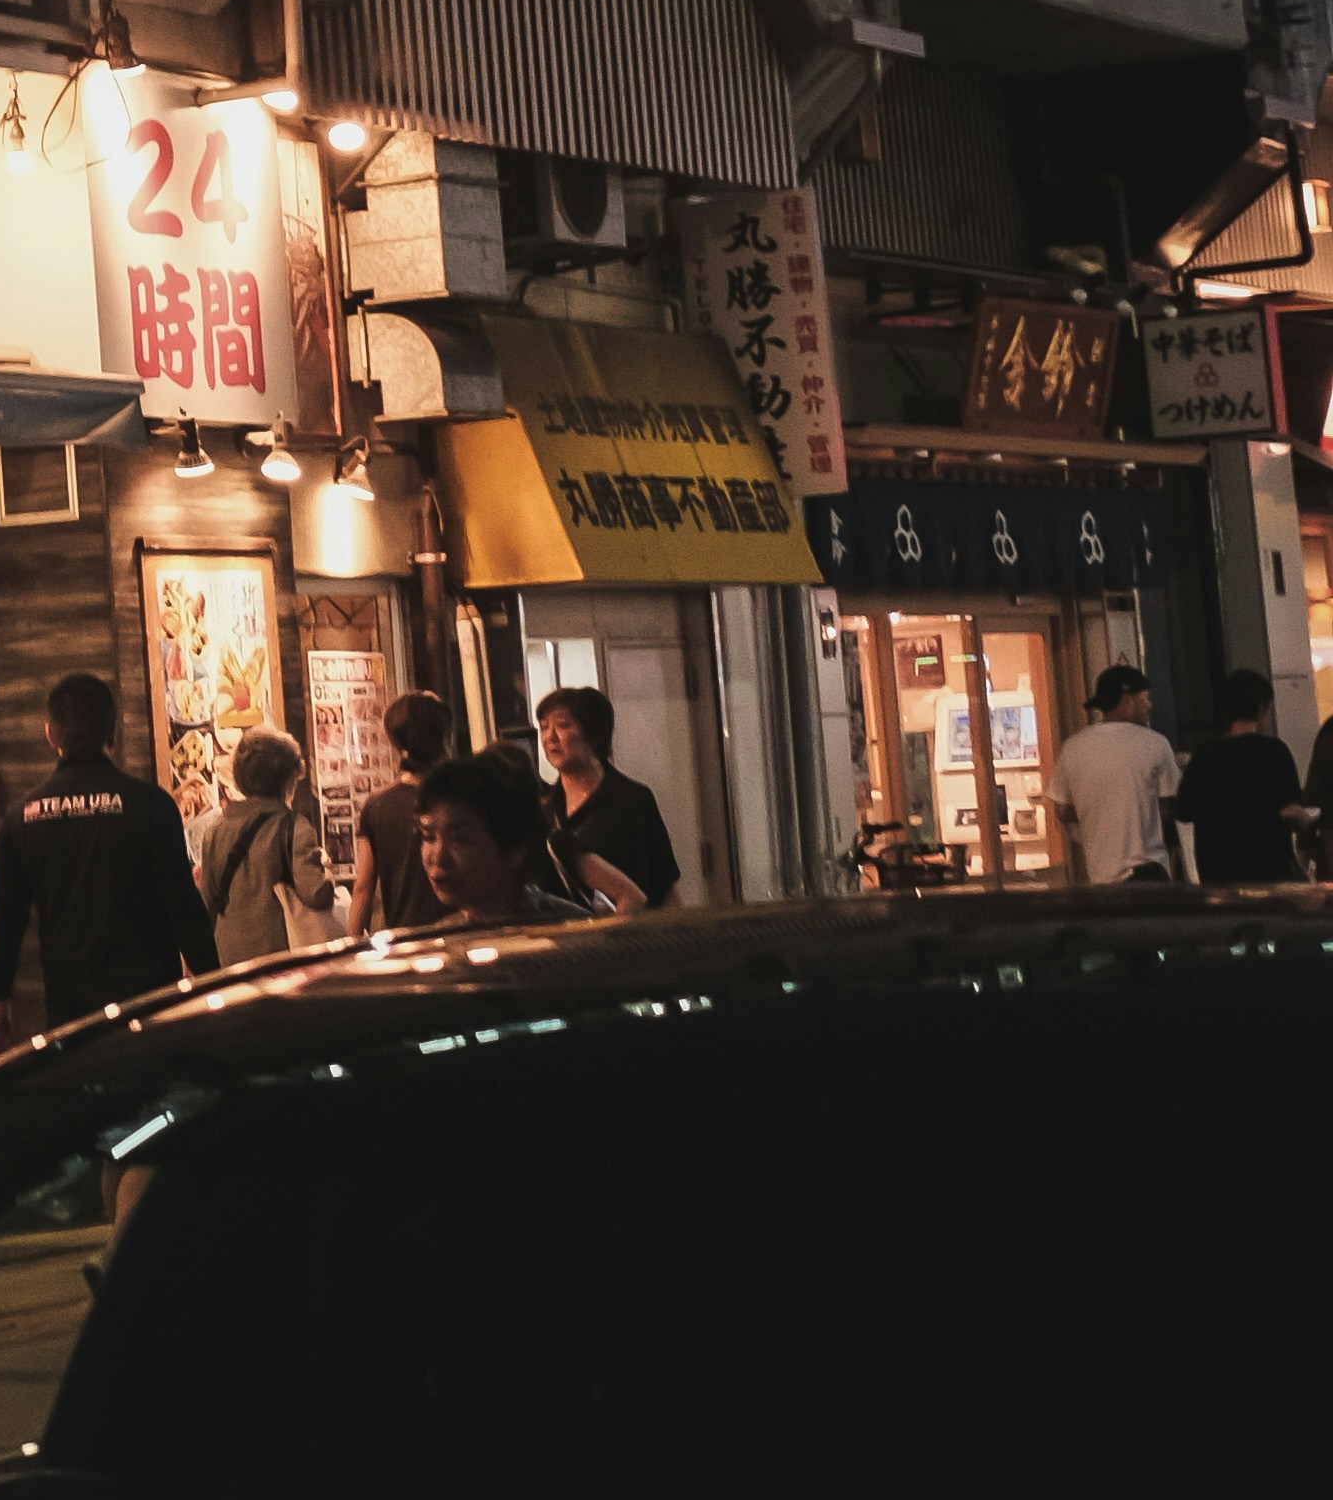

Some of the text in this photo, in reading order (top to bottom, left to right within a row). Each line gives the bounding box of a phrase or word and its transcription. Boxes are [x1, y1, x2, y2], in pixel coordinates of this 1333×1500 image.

[126, 118, 250, 244] 24
[126, 263, 267, 394] 時間
[1150, 319, 1256, 364] 中華そば
[1158, 389, 1266, 426] つけめん
[556, 466, 792, 534] 丸勝商事不動産部
